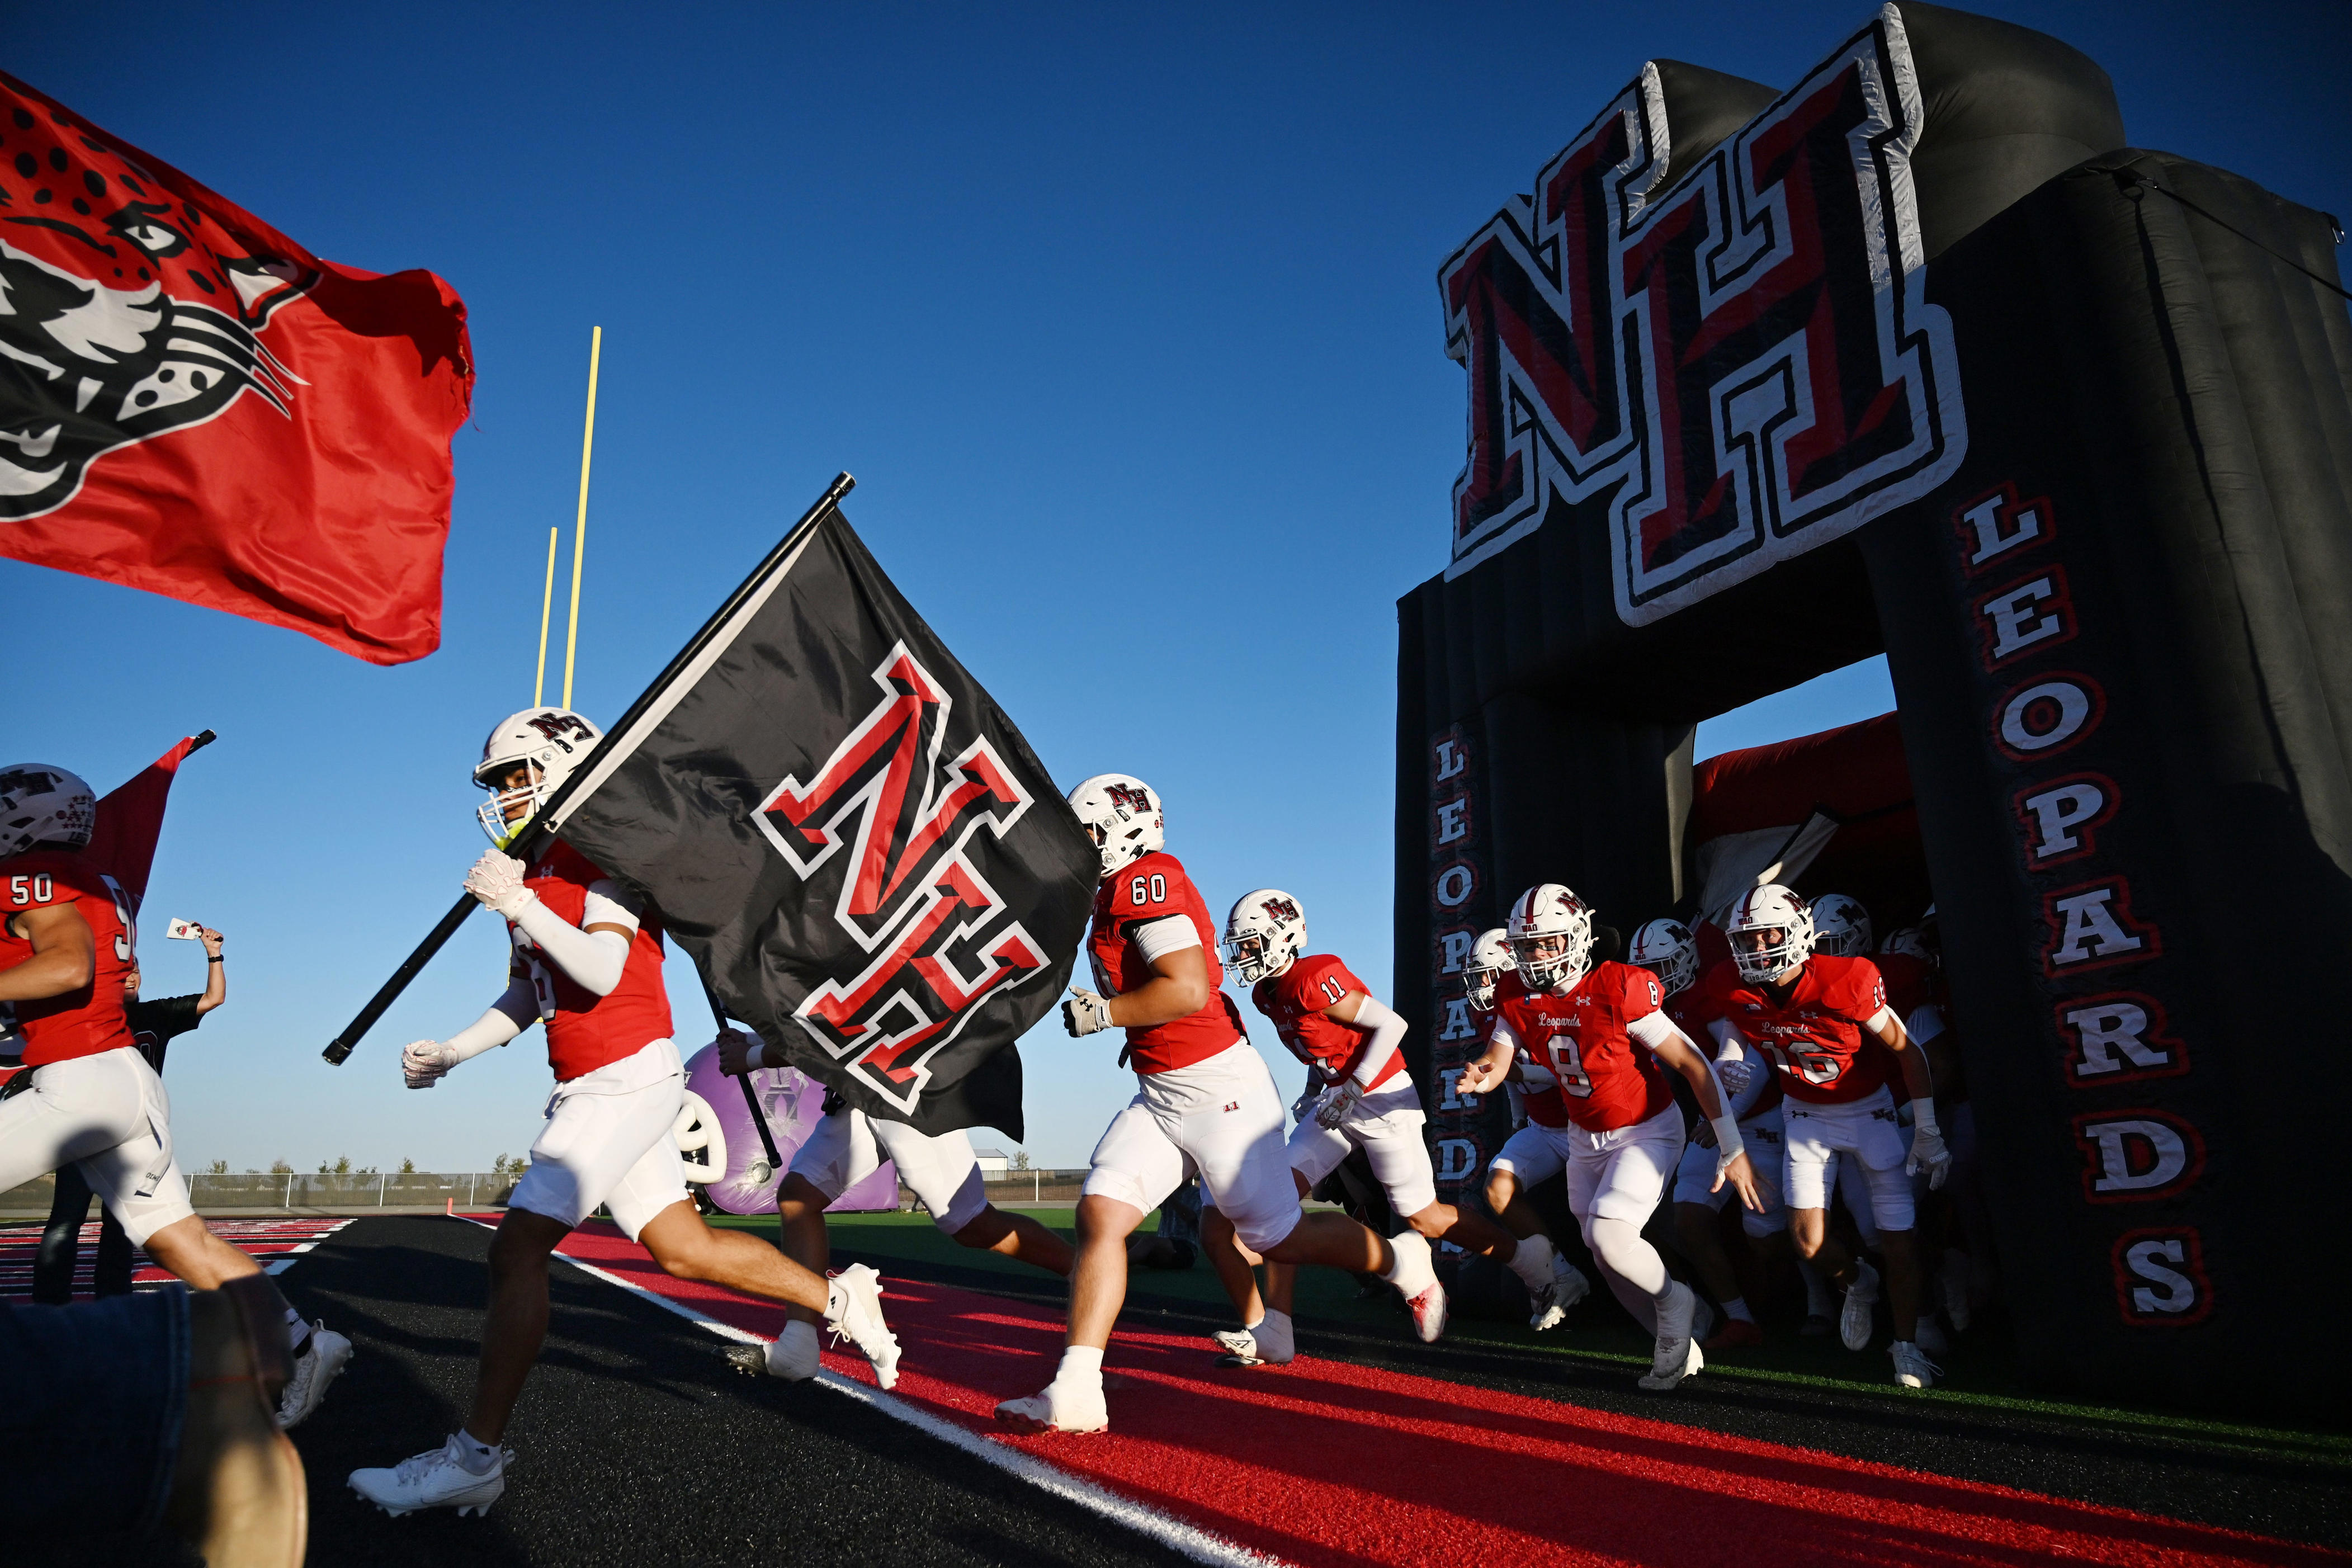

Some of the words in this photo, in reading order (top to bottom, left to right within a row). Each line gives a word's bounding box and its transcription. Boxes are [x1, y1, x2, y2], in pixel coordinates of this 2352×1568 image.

[1437, 2, 1968, 627] NH
[526, 712, 596, 743] NH
[1103, 783, 1153, 814] NH
[11, 872, 53, 905] 50
[752, 639, 1051, 1116] NH
[1131, 873, 1166, 906] 60
[1259, 897, 1301, 923] NH
[1963, 494, 2195, 1314] LEOPARDS
[1320, 975, 1347, 1005] 11
[1435, 739, 1477, 1253] LEOPARD
[1647, 980, 1659, 1007] 8
[1538, 1012, 1581, 1031] Leopards
[1761, 1021, 1811, 1038] Leopards
[1547, 1034, 1594, 1099] 8
[1761, 1040, 1840, 1085] 16
